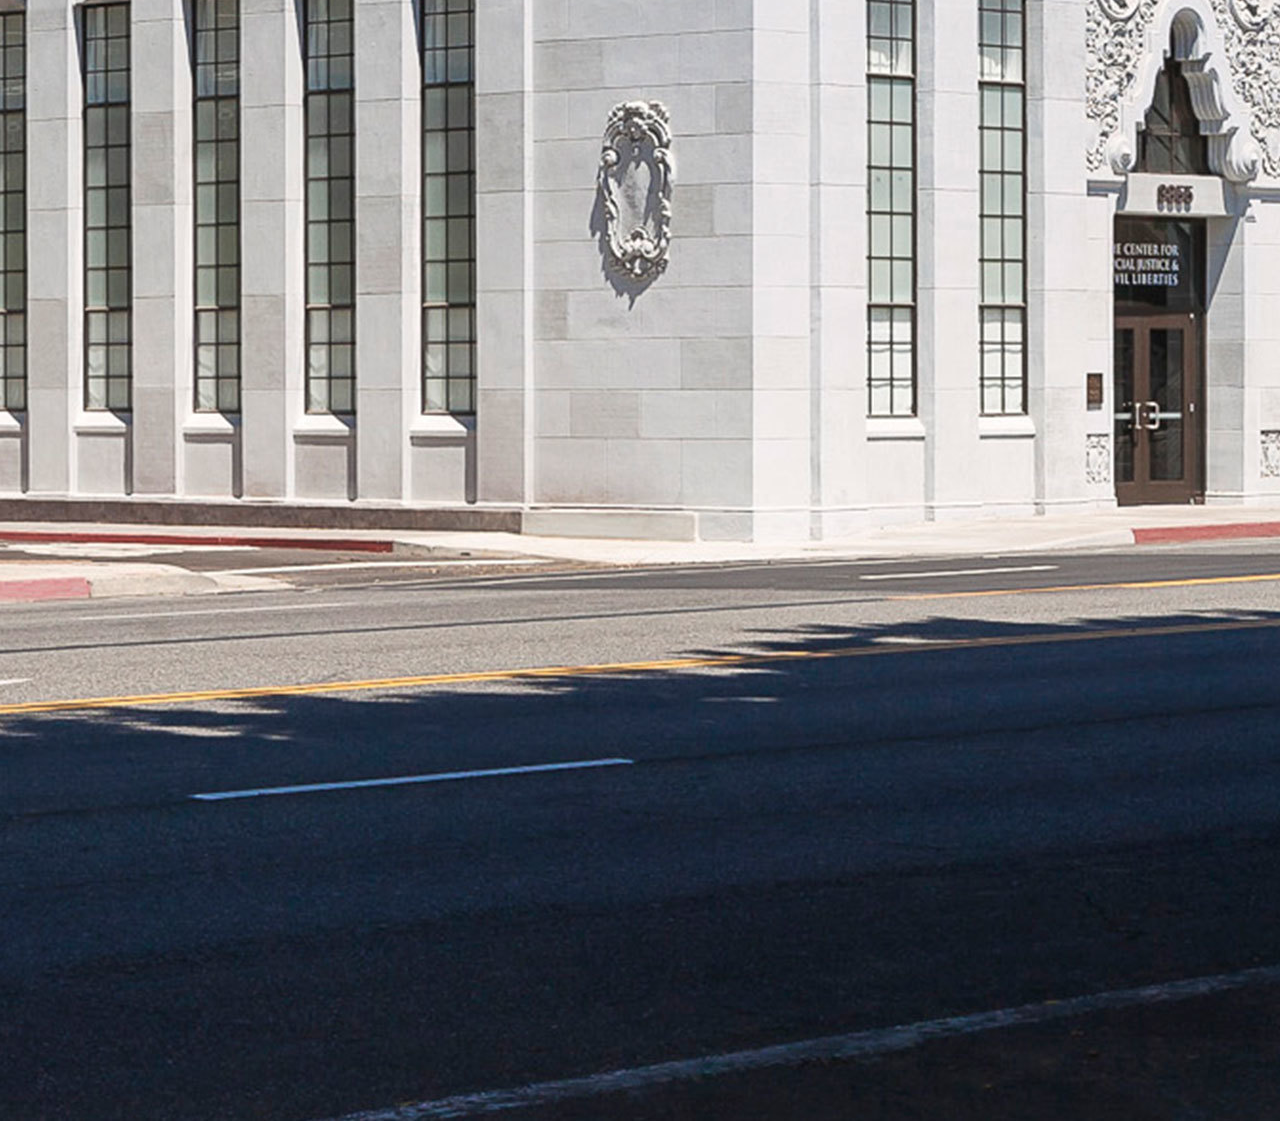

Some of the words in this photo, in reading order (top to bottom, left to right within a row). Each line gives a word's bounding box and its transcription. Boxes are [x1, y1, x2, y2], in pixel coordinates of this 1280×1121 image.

[1123, 243, 1159, 255] CENTER
[1160, 244, 1179, 256] FOR
[1114, 258, 1135, 270] CIAL
[1136, 258, 1170, 271] JUSTICE
[1171, 259, 1179, 271] &
[1115, 273, 1131, 285] VIL
[1132, 273, 1178, 286] LIBERTIES
